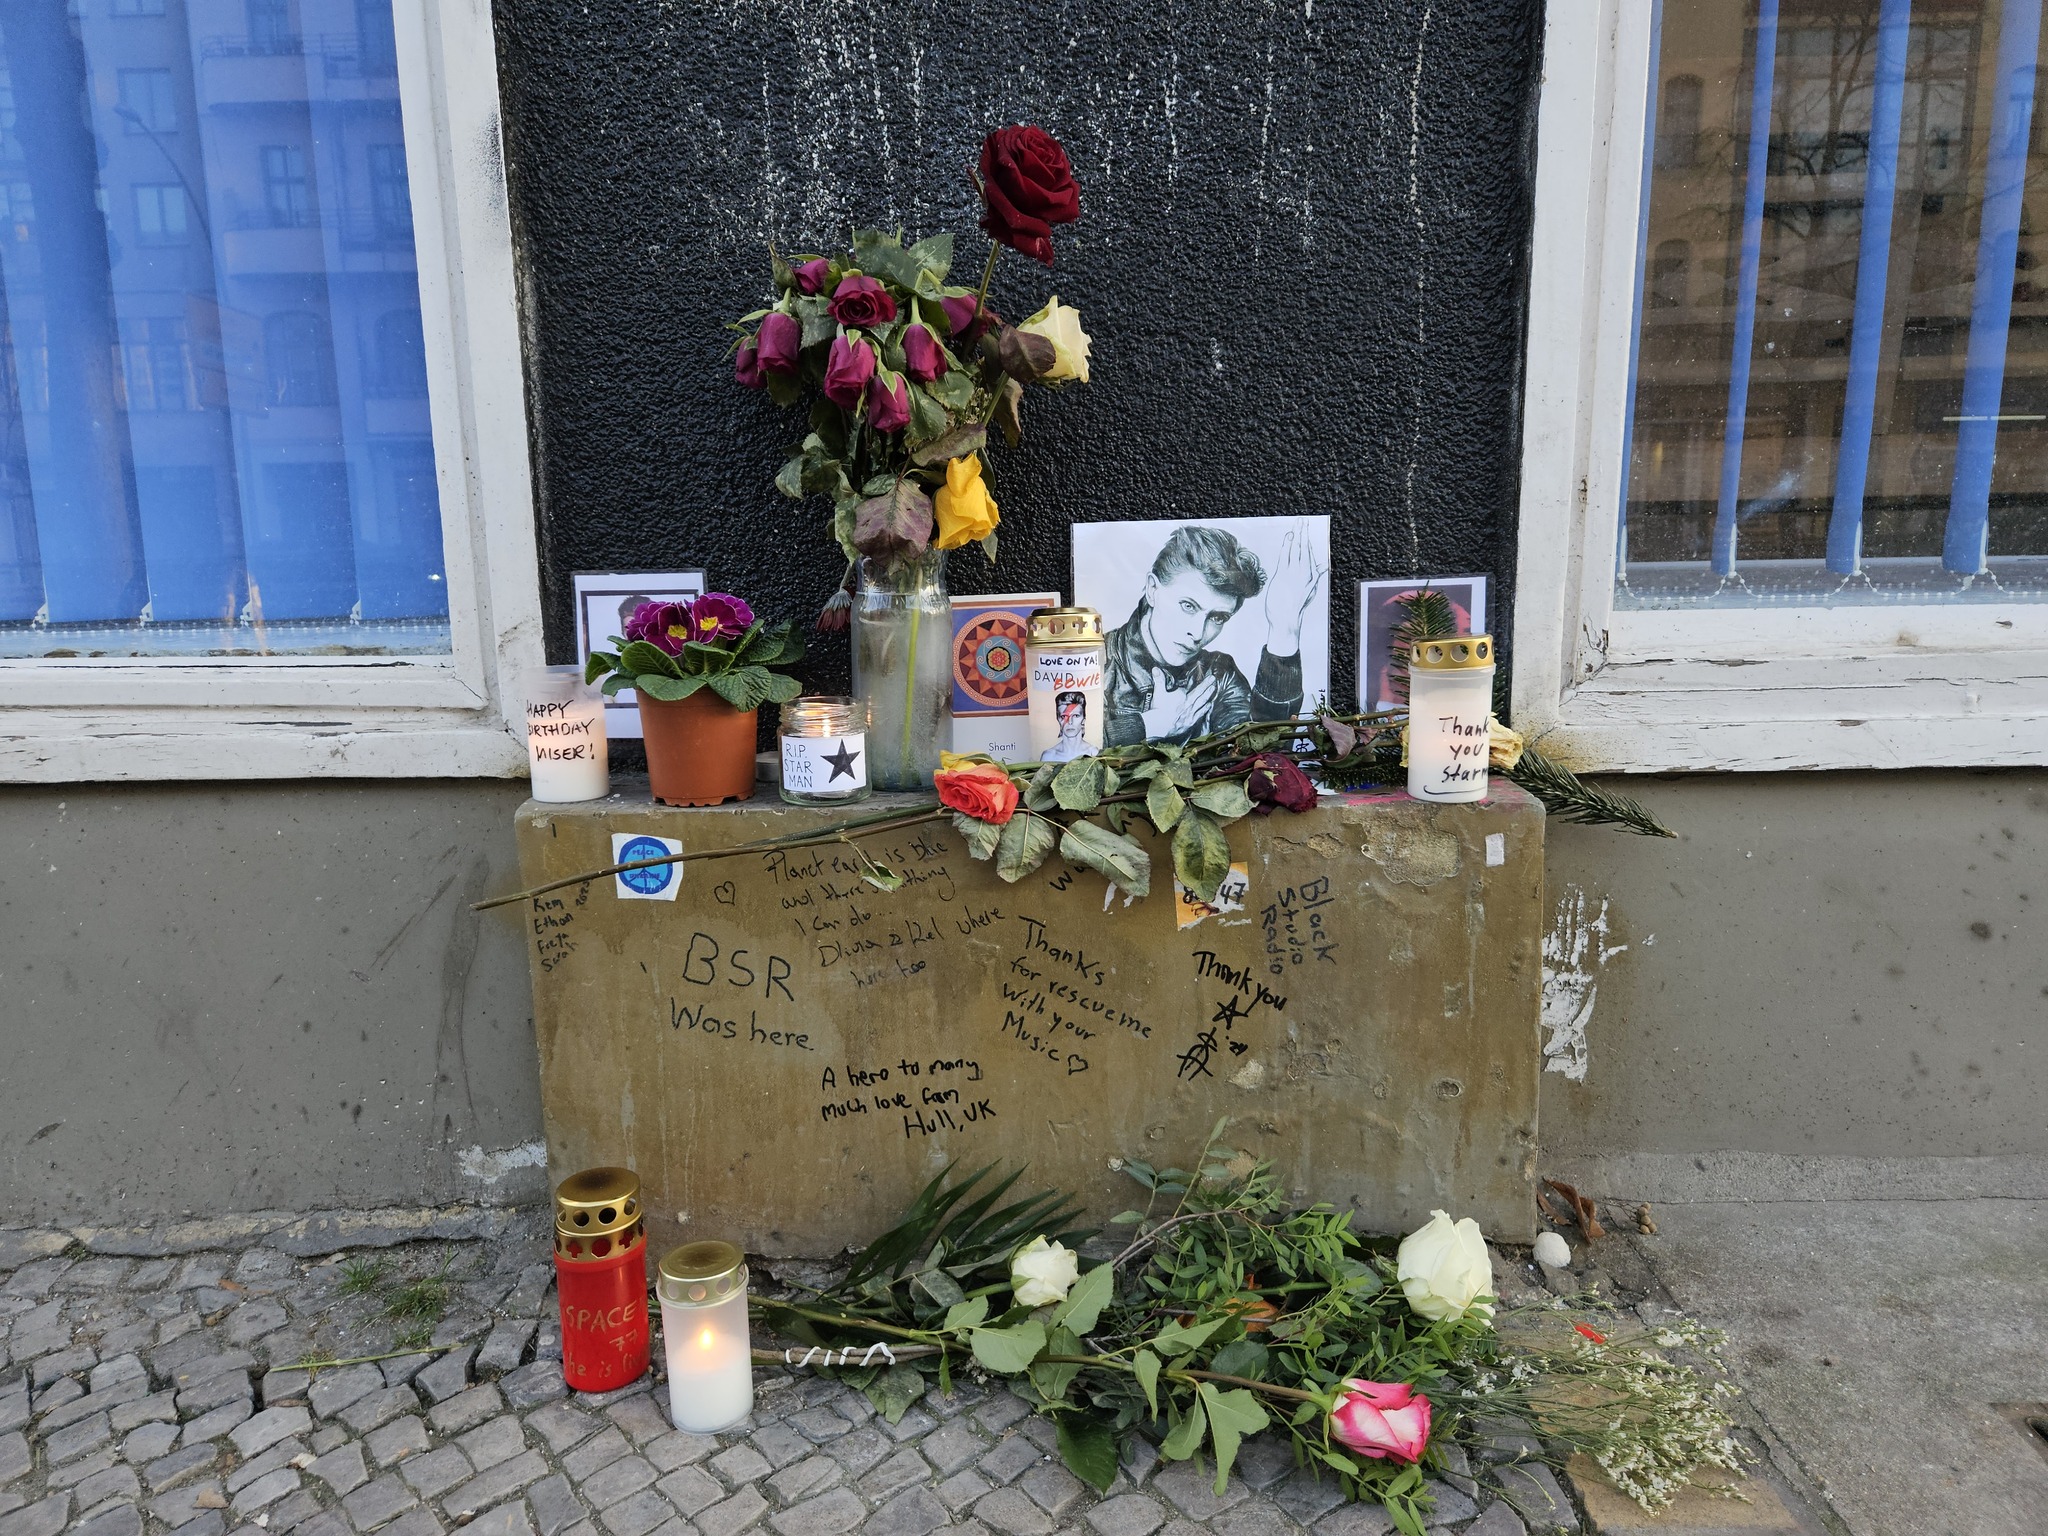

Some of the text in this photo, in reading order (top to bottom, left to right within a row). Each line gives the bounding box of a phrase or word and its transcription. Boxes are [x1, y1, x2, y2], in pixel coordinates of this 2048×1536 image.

[1040, 656, 1063, 666] LOVE
[1066, 656, 1080, 666] ON
[1034, 670, 1074, 683] DAVID
[526, 699, 574, 719] HAPPY
[1438, 715, 1489, 737] Thank
[988, 742, 1016, 752] Shanti
[784, 758, 813, 774] STAR
[788, 775, 813, 788] MAN
[885, 847, 906, 865] is
[781, 888, 814, 910] and
[682, 932, 795, 1002] BSR
[1192, 950, 1253, 995] Thank
[821, 1066, 836, 1092] A
[846, 1065, 890, 1088] hero
[897, 1059, 920, 1076] to
[874, 1092, 913, 1110] love
[963, 1098, 998, 1122] UK
[566, 1299, 638, 1335] SPACE
